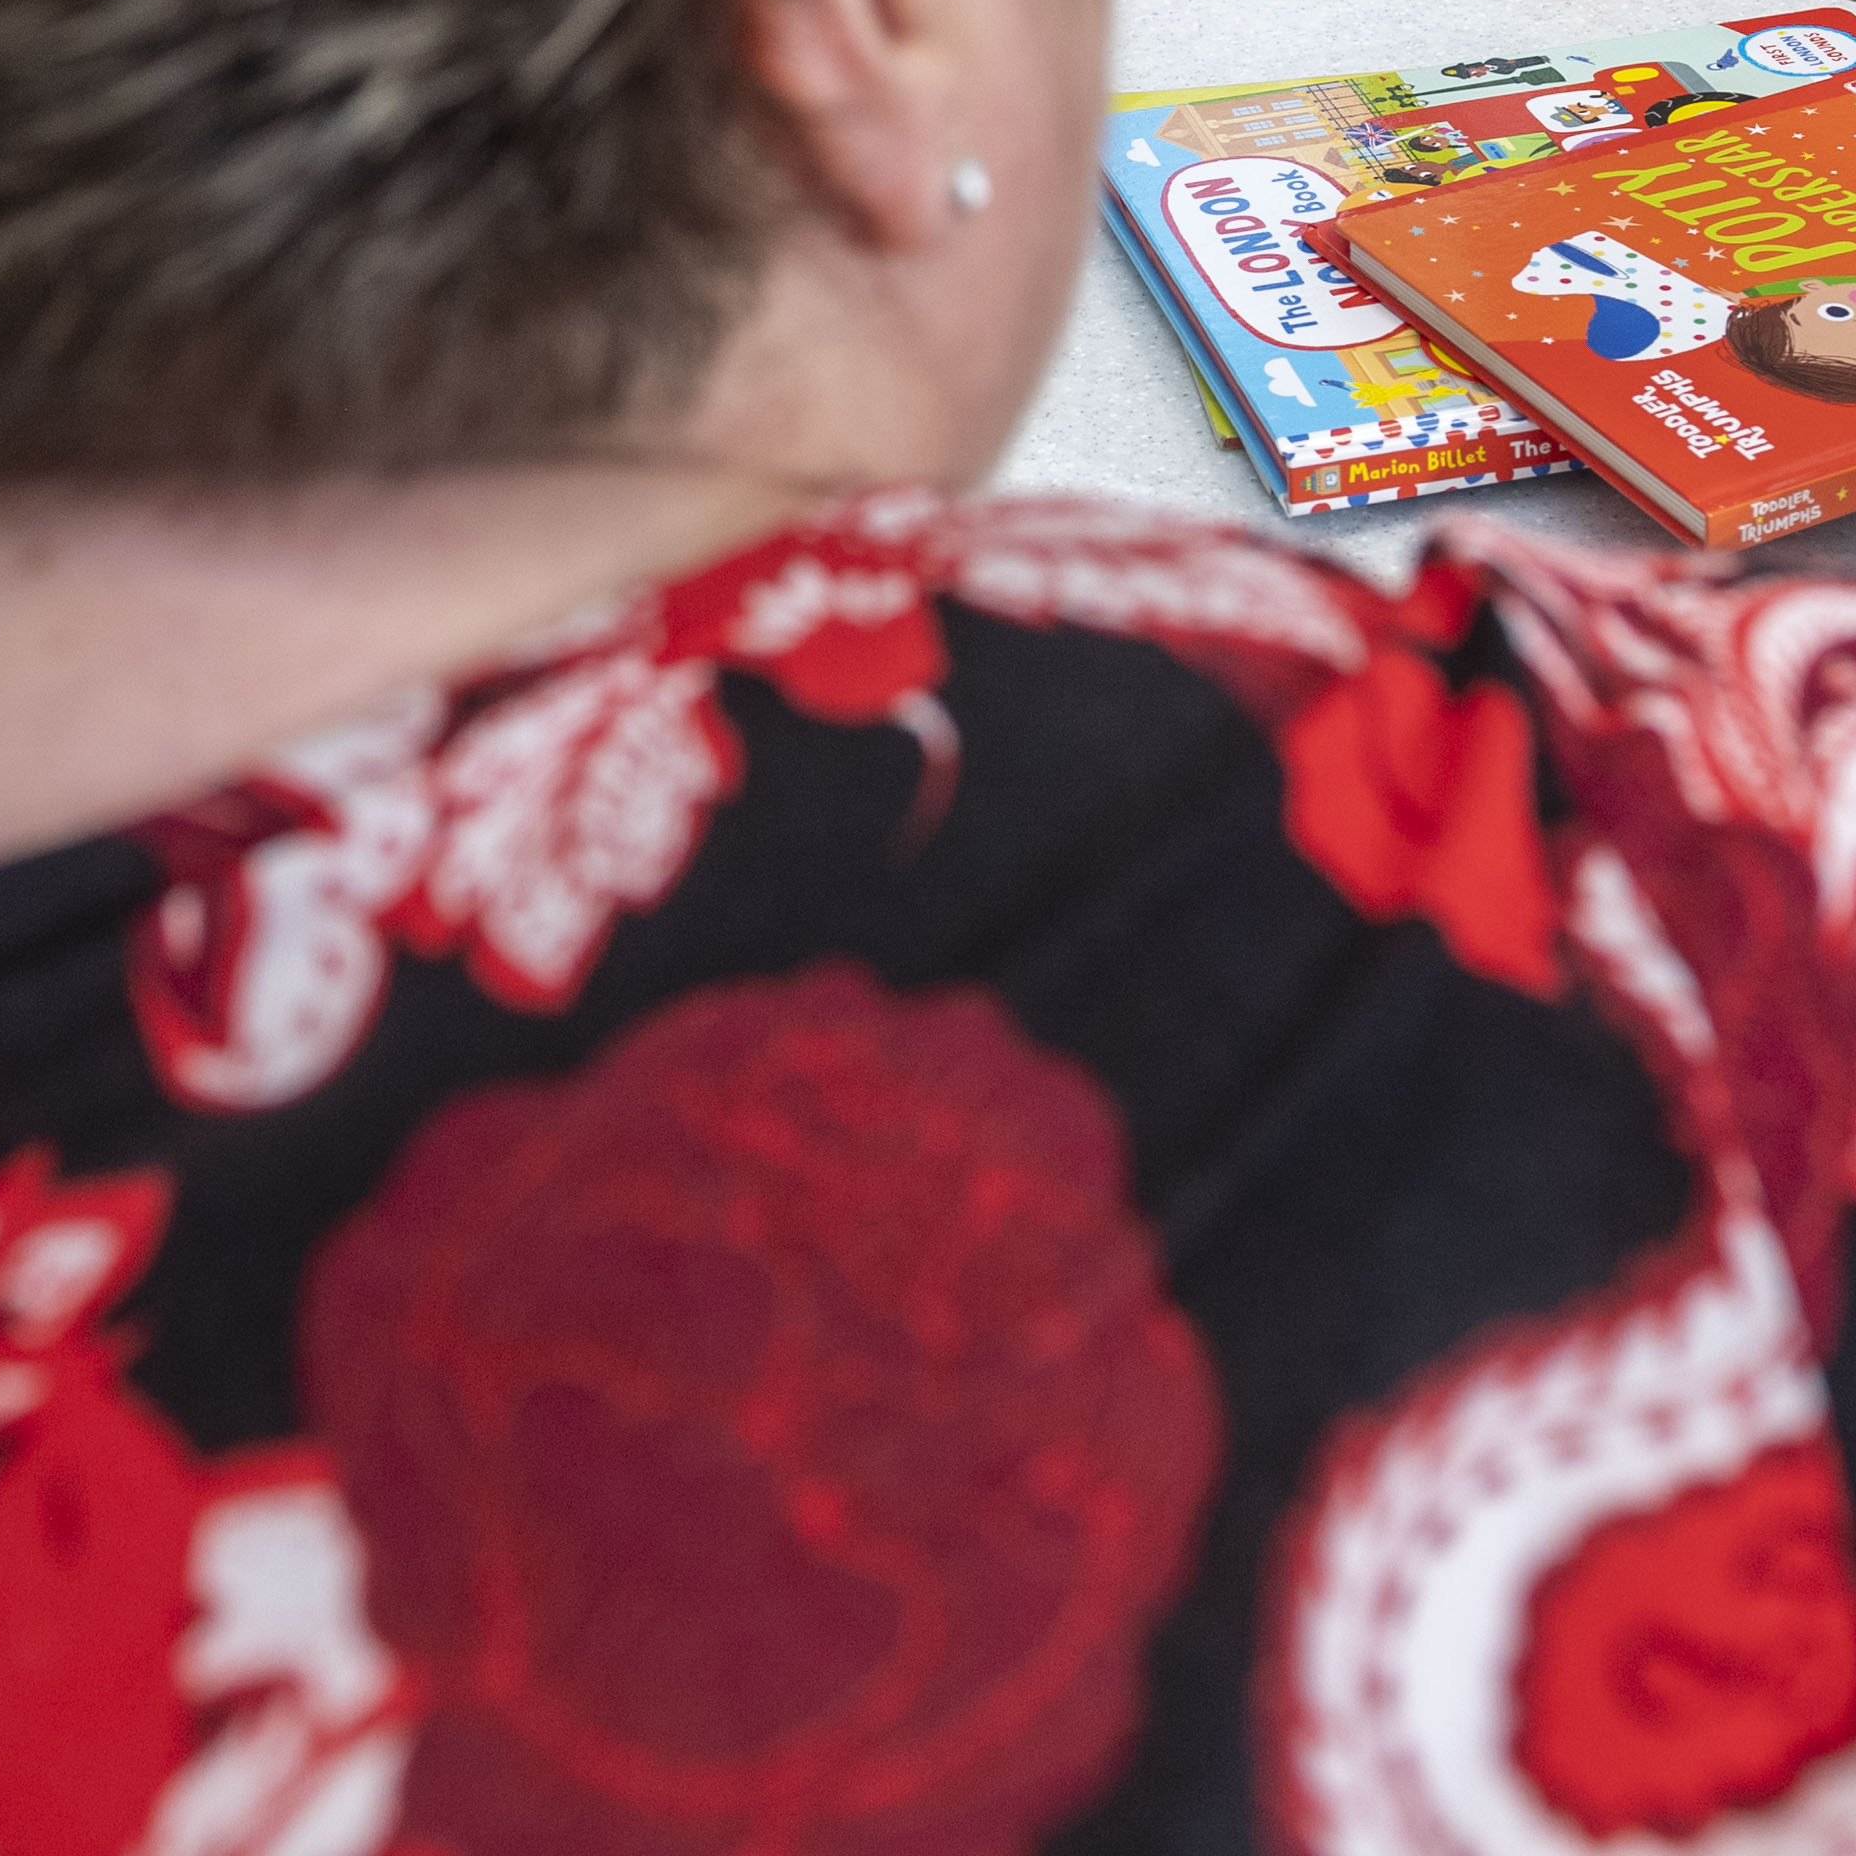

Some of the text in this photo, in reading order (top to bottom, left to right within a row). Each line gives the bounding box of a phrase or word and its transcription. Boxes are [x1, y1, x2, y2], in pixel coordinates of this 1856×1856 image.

[1759, 44, 1795, 66] FIRST
[1779, 35, 1825, 67] LONDON
[1803, 32, 1848, 62] SOUNDS
[1271, 169, 1326, 214] Book
[1184, 177, 1319, 335] The LONDON
[1632, 385, 1723, 459] TODDLER
[1650, 369, 1775, 461] TRIUMPHS
[1348, 439, 1552, 484] Marion Billet The
[1738, 505, 1822, 543] TRIUMPHS
[1750, 489, 1815, 518] TODDLER
